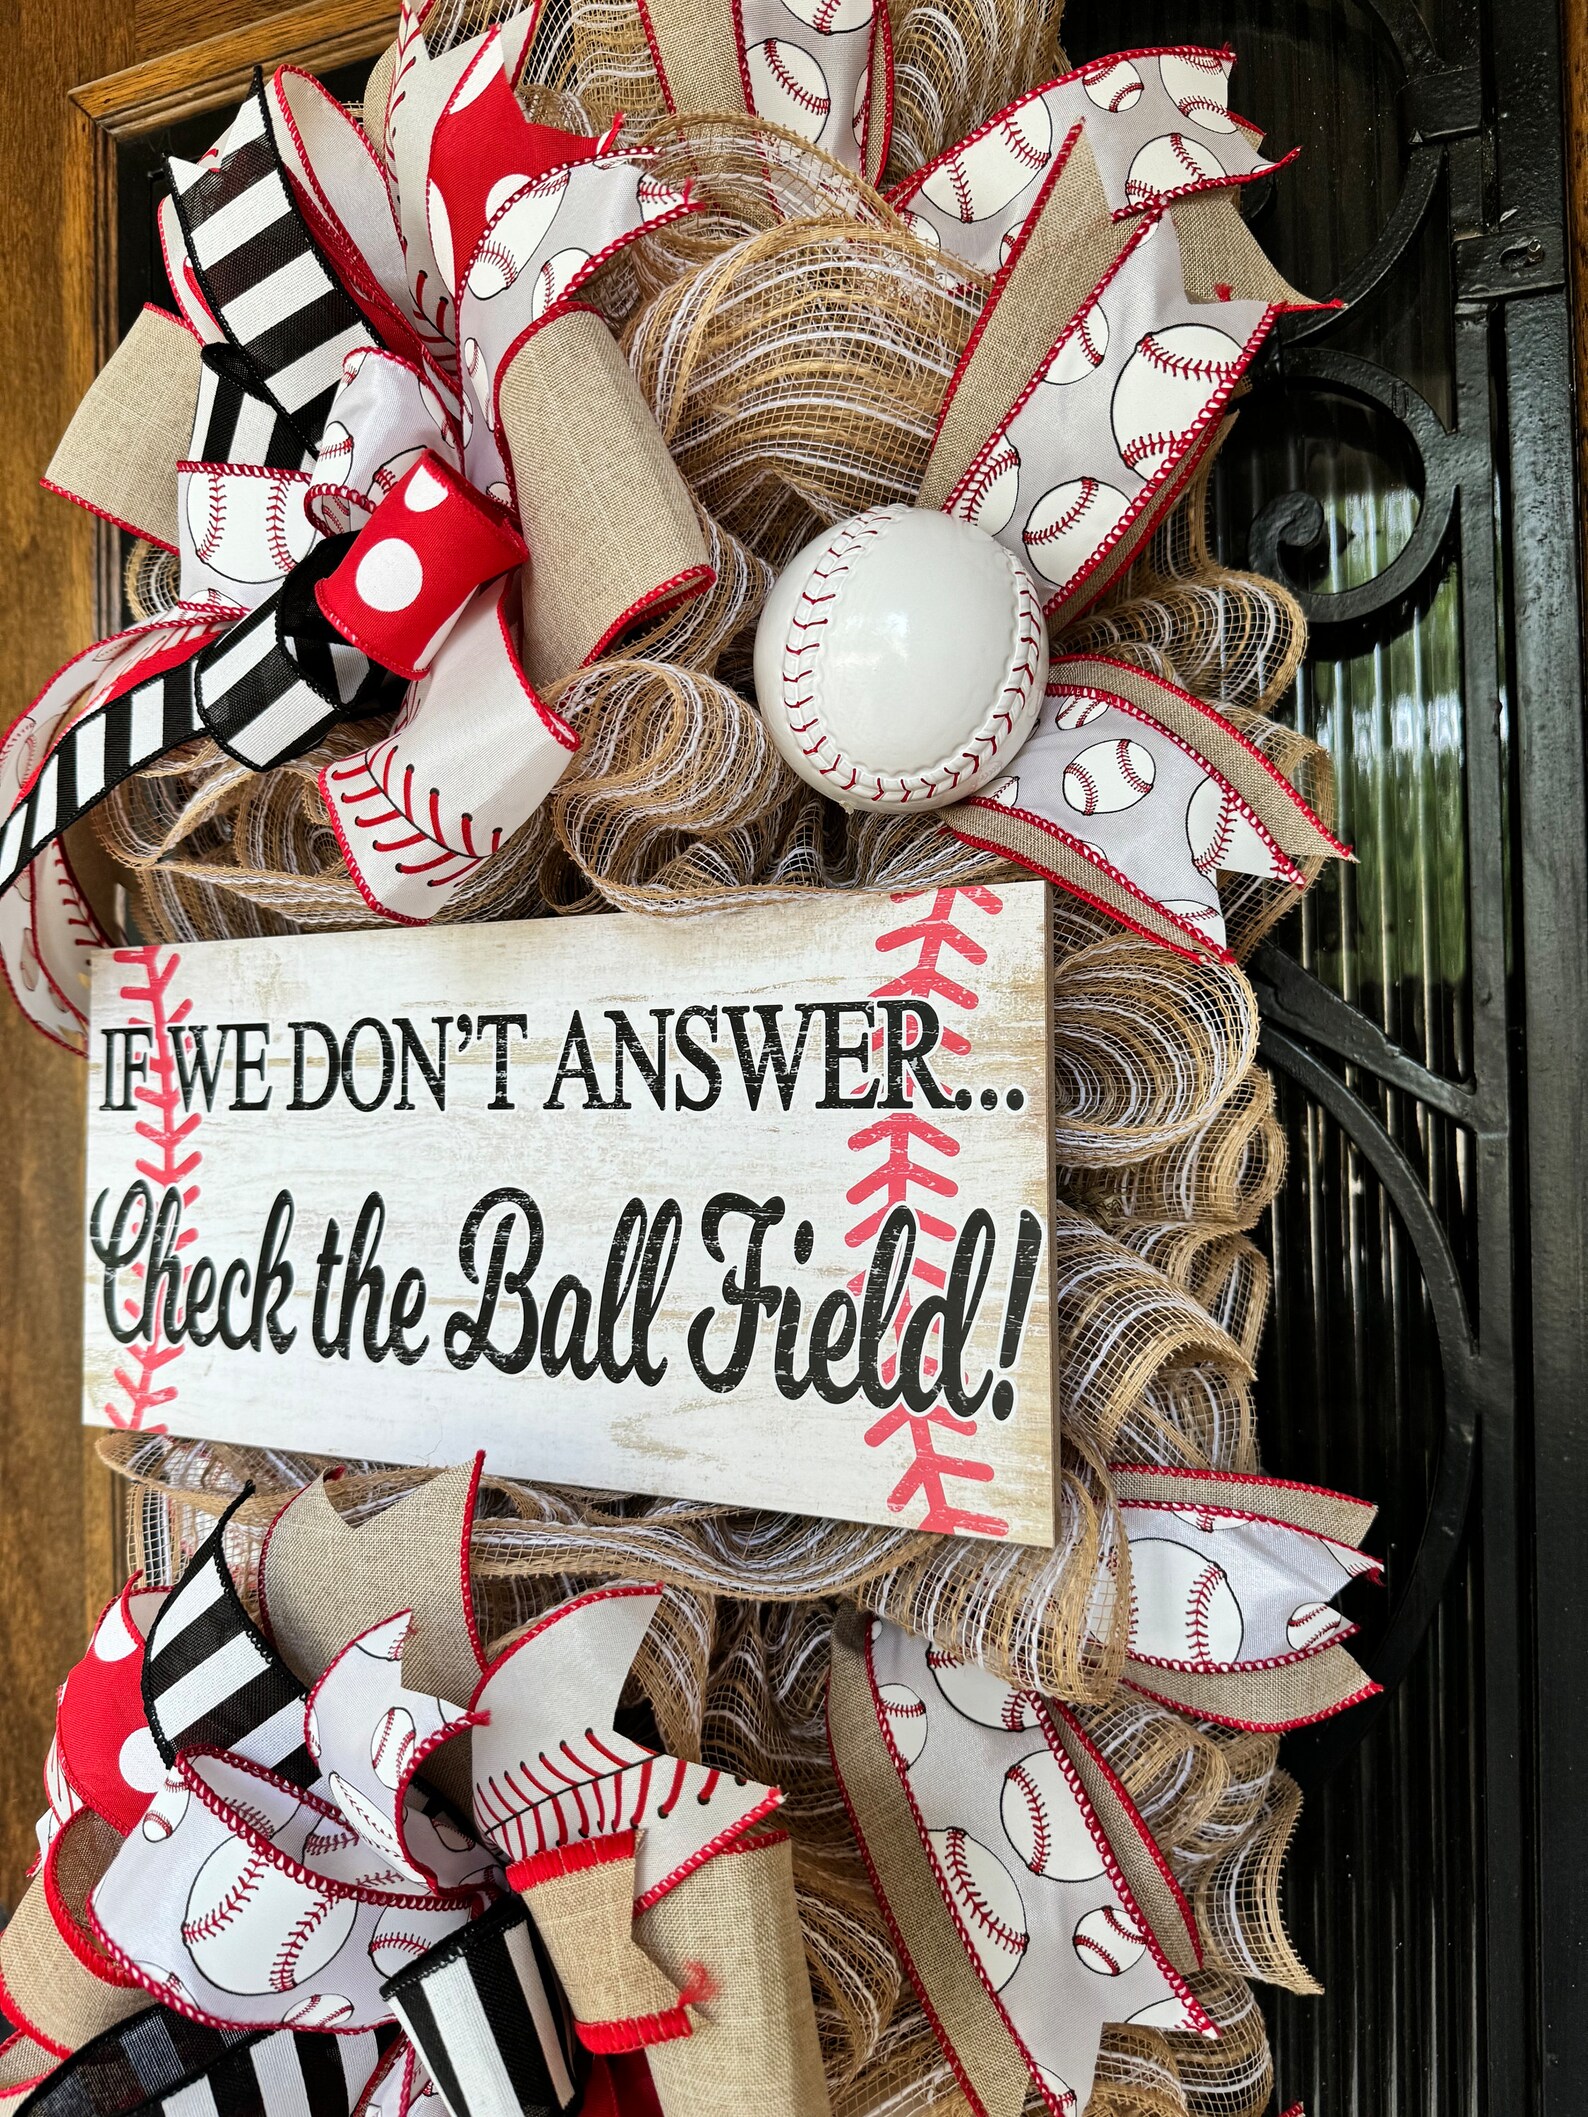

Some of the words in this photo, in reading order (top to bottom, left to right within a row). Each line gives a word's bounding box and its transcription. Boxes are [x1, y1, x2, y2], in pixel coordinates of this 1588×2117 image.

[99, 1027, 152, 1111] IF
[167, 1022, 272, 1113] WE
[286, 1013, 528, 1113] DON’T
[542, 999, 1024, 1112] ANSWER...
[90, 1179, 297, 1355] Check
[312, 1191, 430, 1366] the
[443, 1187, 683, 1387] Ball
[687, 1192, 1042, 1421] Field!
